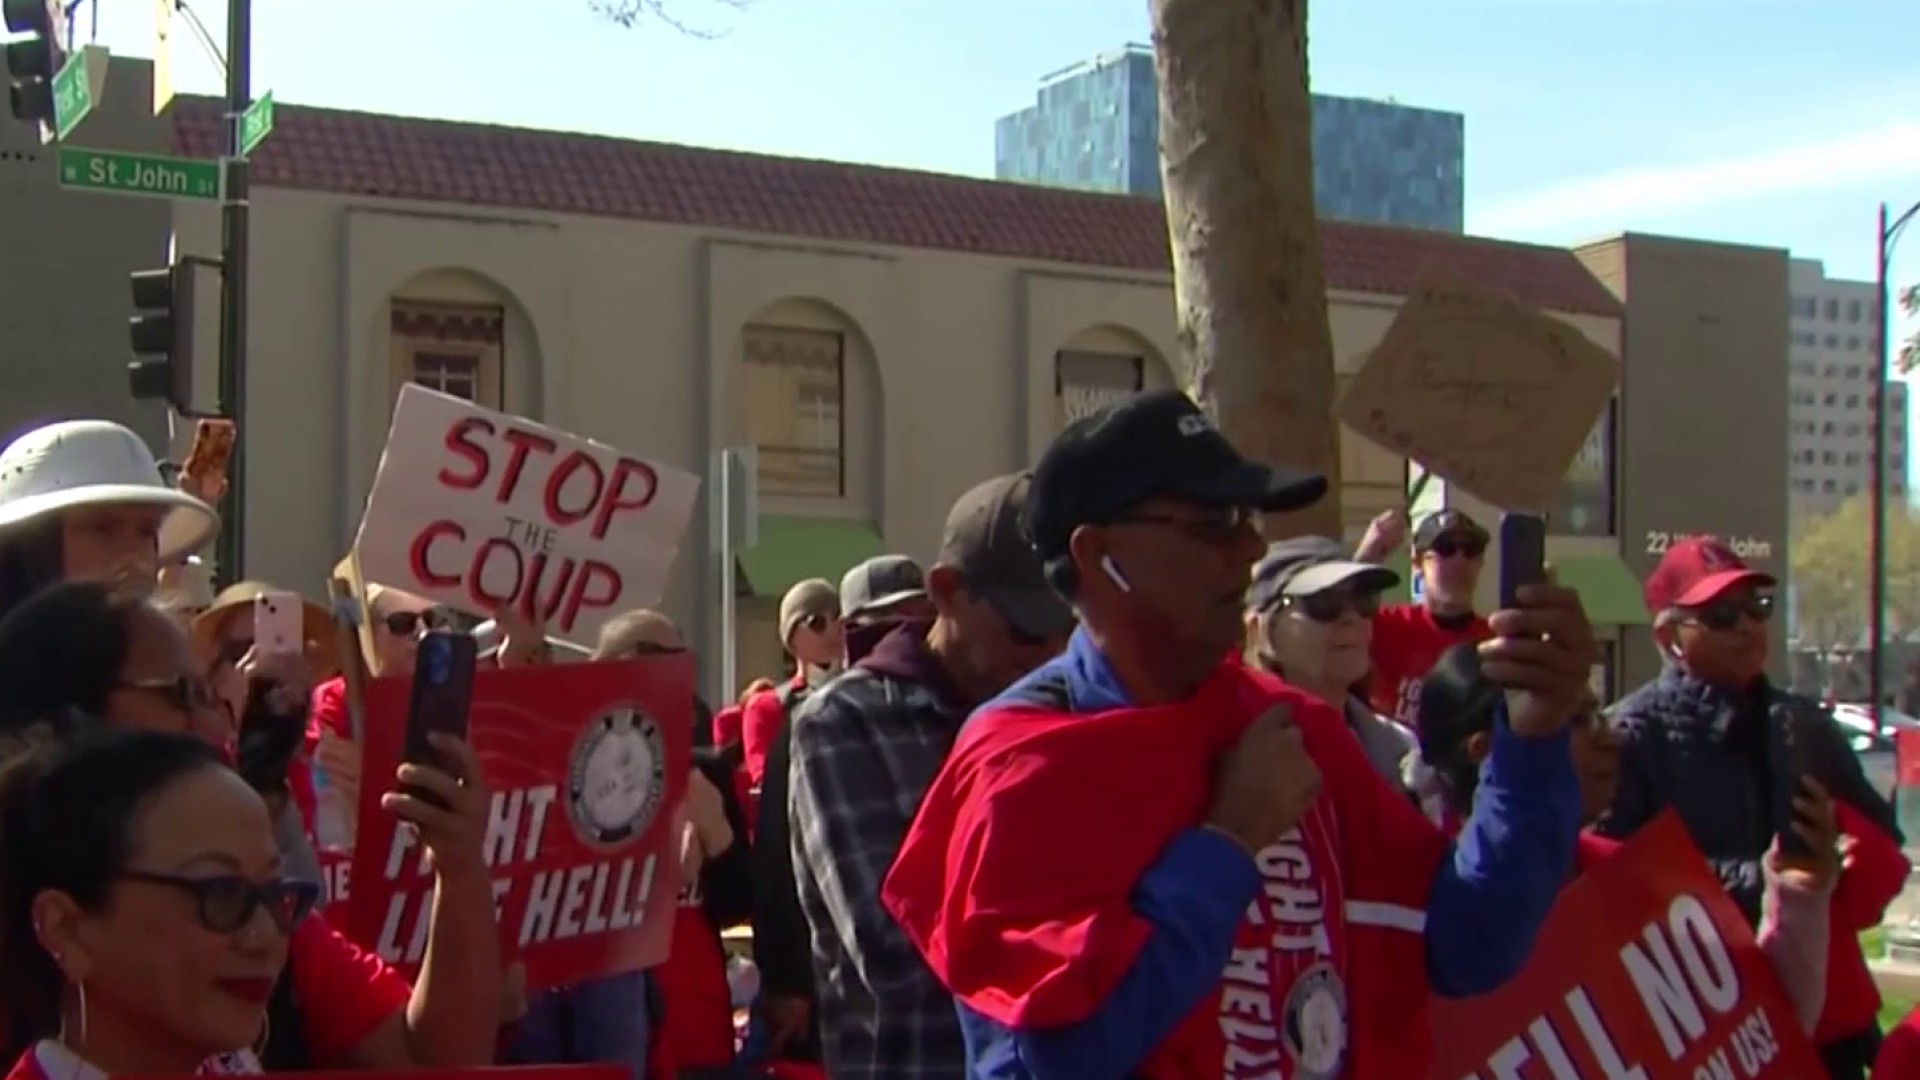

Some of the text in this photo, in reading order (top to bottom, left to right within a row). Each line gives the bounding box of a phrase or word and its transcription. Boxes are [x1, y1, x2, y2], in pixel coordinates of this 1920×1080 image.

[89, 157, 118, 185] St
[125, 161, 187, 191] John
[438, 417, 658, 540] STOP
[410, 519, 622, 633] COUP
[504, 516, 559, 549] THE
[1646, 531, 1669, 553] 22
[384, 785, 557, 881] FHT
[518, 855, 657, 948] HELL!
[1255, 828, 1331, 956] GHT
[1619, 894, 1740, 1061] NO
[1730, 1005, 1779, 1077] US!
